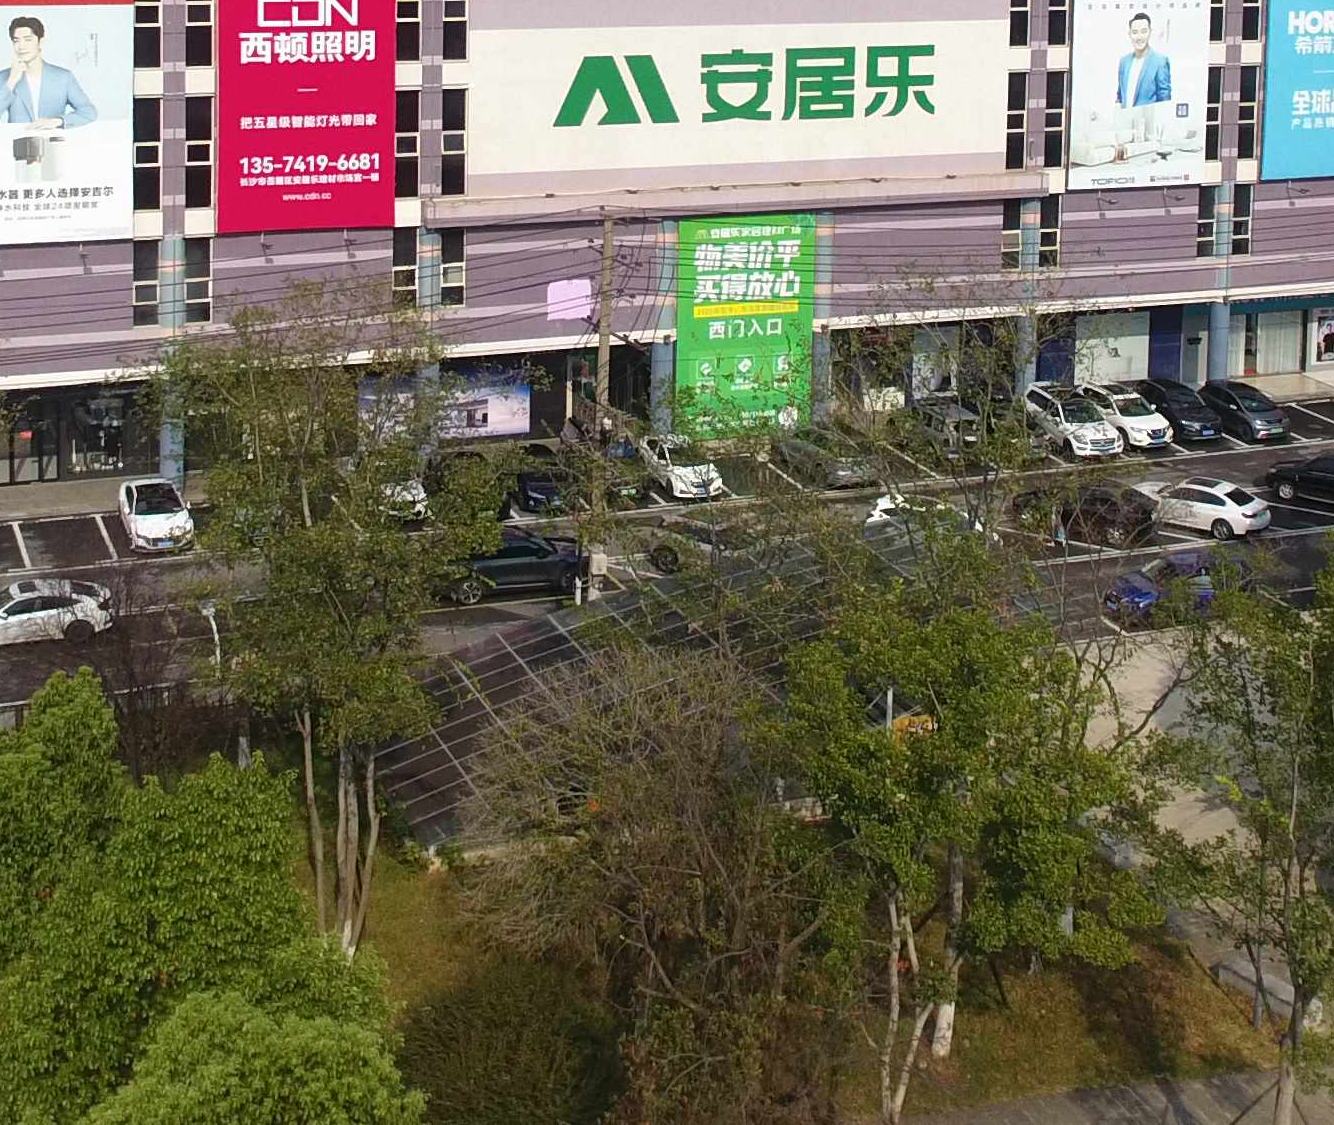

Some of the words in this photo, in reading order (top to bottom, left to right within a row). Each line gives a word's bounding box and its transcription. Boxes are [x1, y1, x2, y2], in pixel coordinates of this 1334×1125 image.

[239, 30, 376, 64] 西顿照明
[700, 45, 935, 123] 安居乐
[240, 113, 377, 130] 把五星级智能灯光带回家
[239, 153, 380, 175] 135-7419-6681
[23, 186, 114, 200] 更多人选择安吉尔
[694, 240, 801, 272] 物美价平
[694, 270, 801, 303] 买得放心
[709, 318, 782, 339] 西门入口
